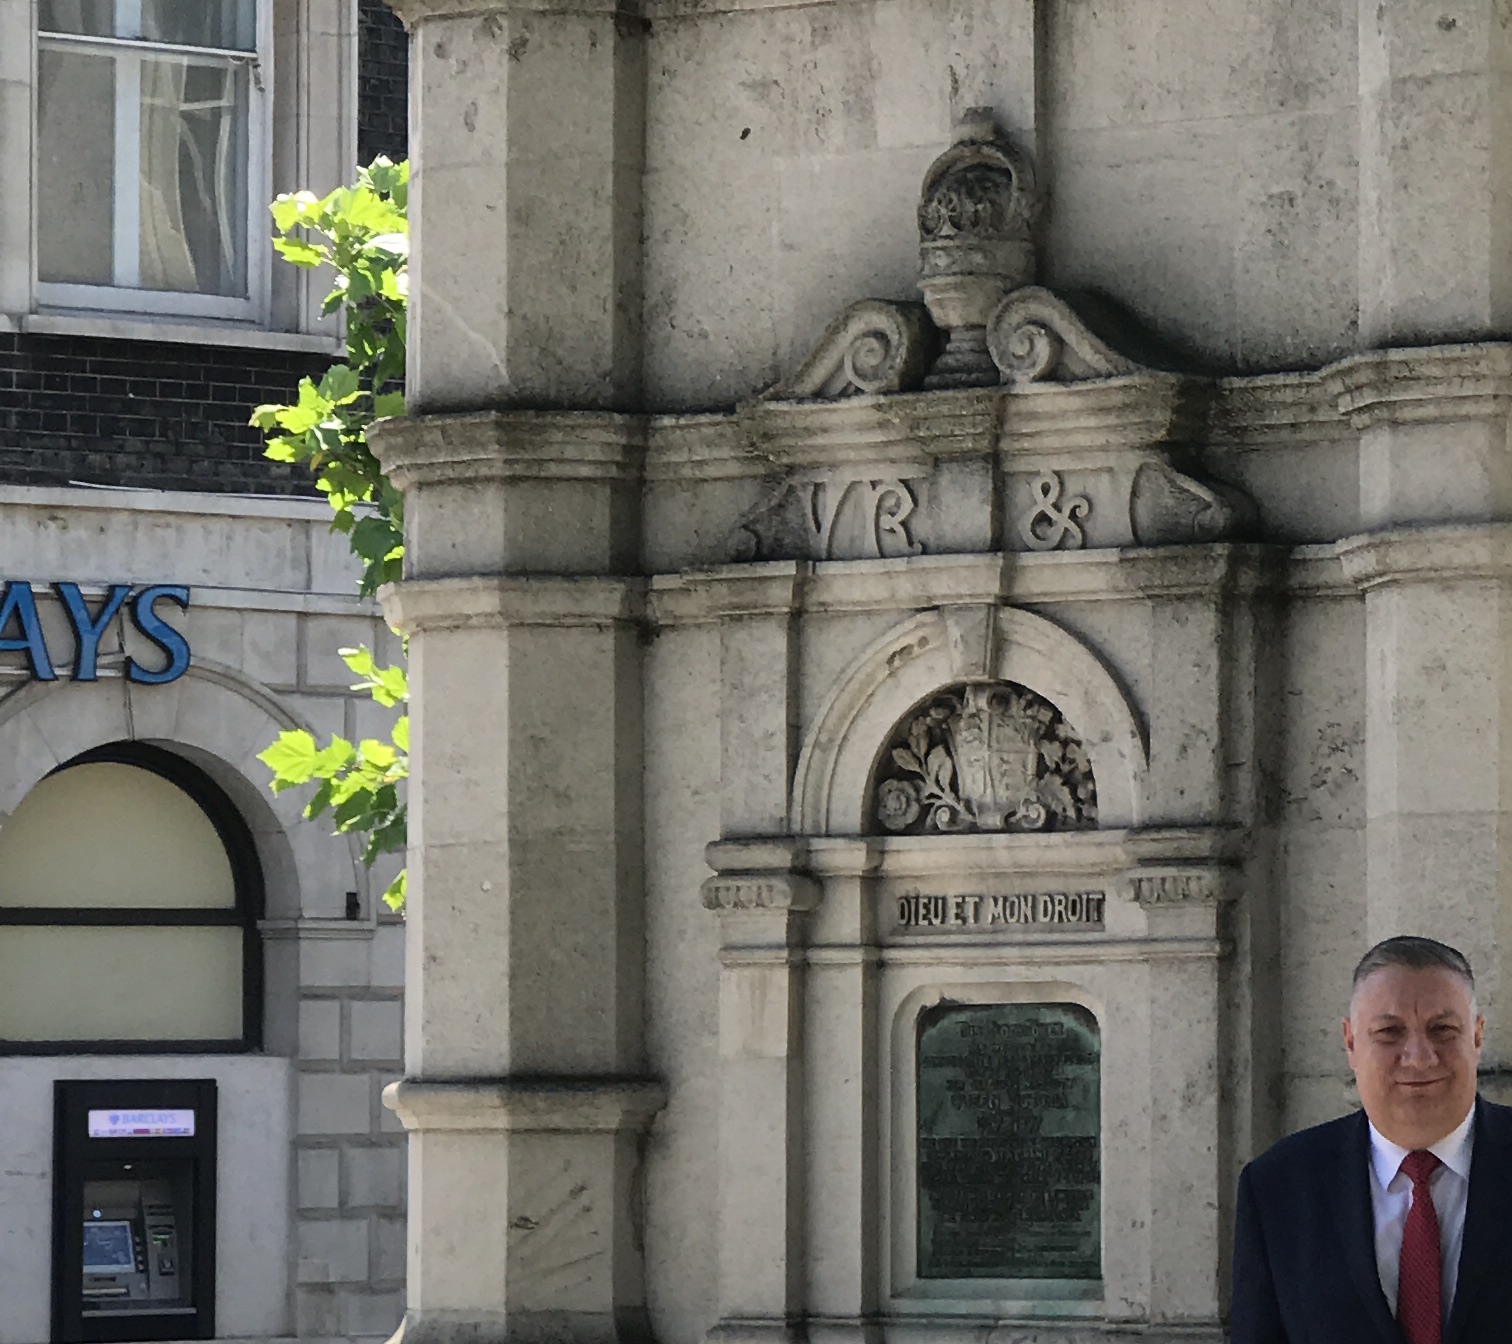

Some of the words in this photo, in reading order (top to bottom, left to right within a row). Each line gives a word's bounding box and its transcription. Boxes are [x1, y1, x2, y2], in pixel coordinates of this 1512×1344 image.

[0, 581, 191, 685] AYS
[898, 895, 944, 926] DIEU
[950, 895, 980, 925] ET
[989, 893, 1033, 924] MON
[1038, 892, 1104, 924] DROIT
[122, 1112, 176, 1124] BARCLAYS
